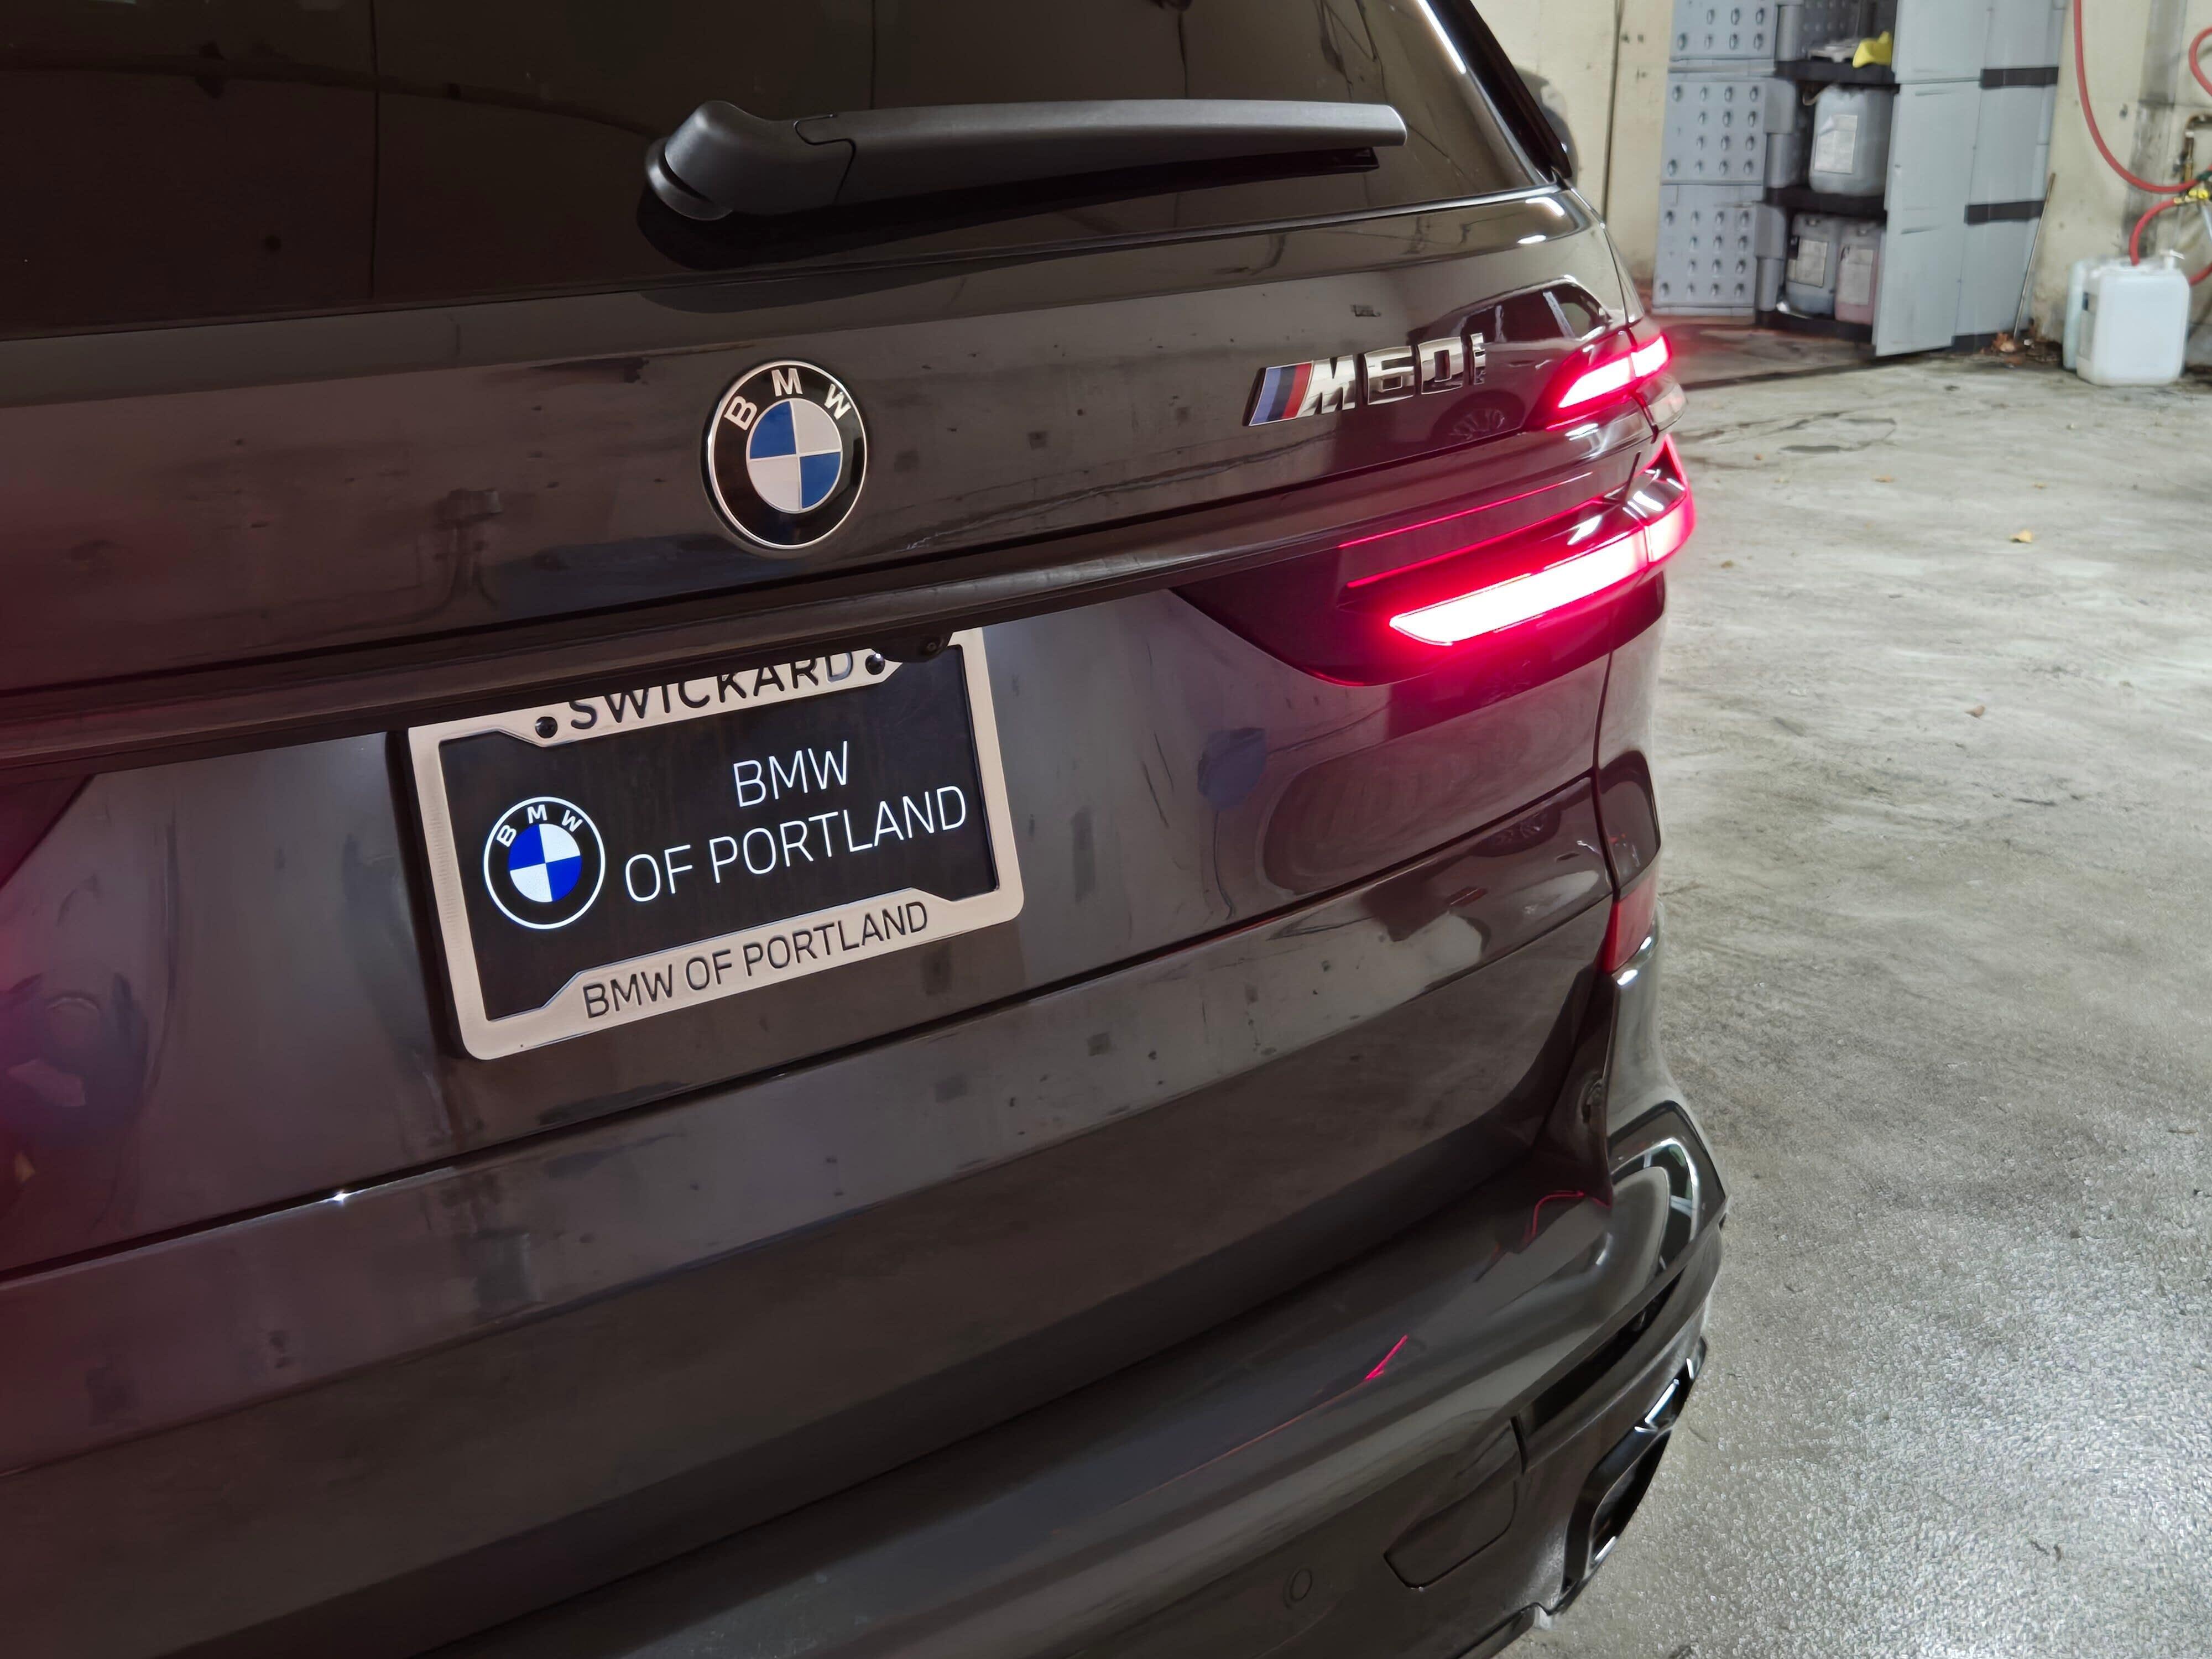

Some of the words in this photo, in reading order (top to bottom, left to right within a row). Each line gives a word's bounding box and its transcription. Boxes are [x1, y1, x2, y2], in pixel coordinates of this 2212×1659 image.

[724, 368, 852, 431] BMW
[569, 651, 854, 730] SWICKARD
[732, 740, 849, 808] BMW
[497, 804, 583, 847] BMW
[625, 844, 692, 903] OF
[709, 785, 967, 884] PORTLAND
[582, 964, 674, 1019] BMW
[685, 950, 732, 992] OF
[742, 901, 928, 977] PORTLAND
